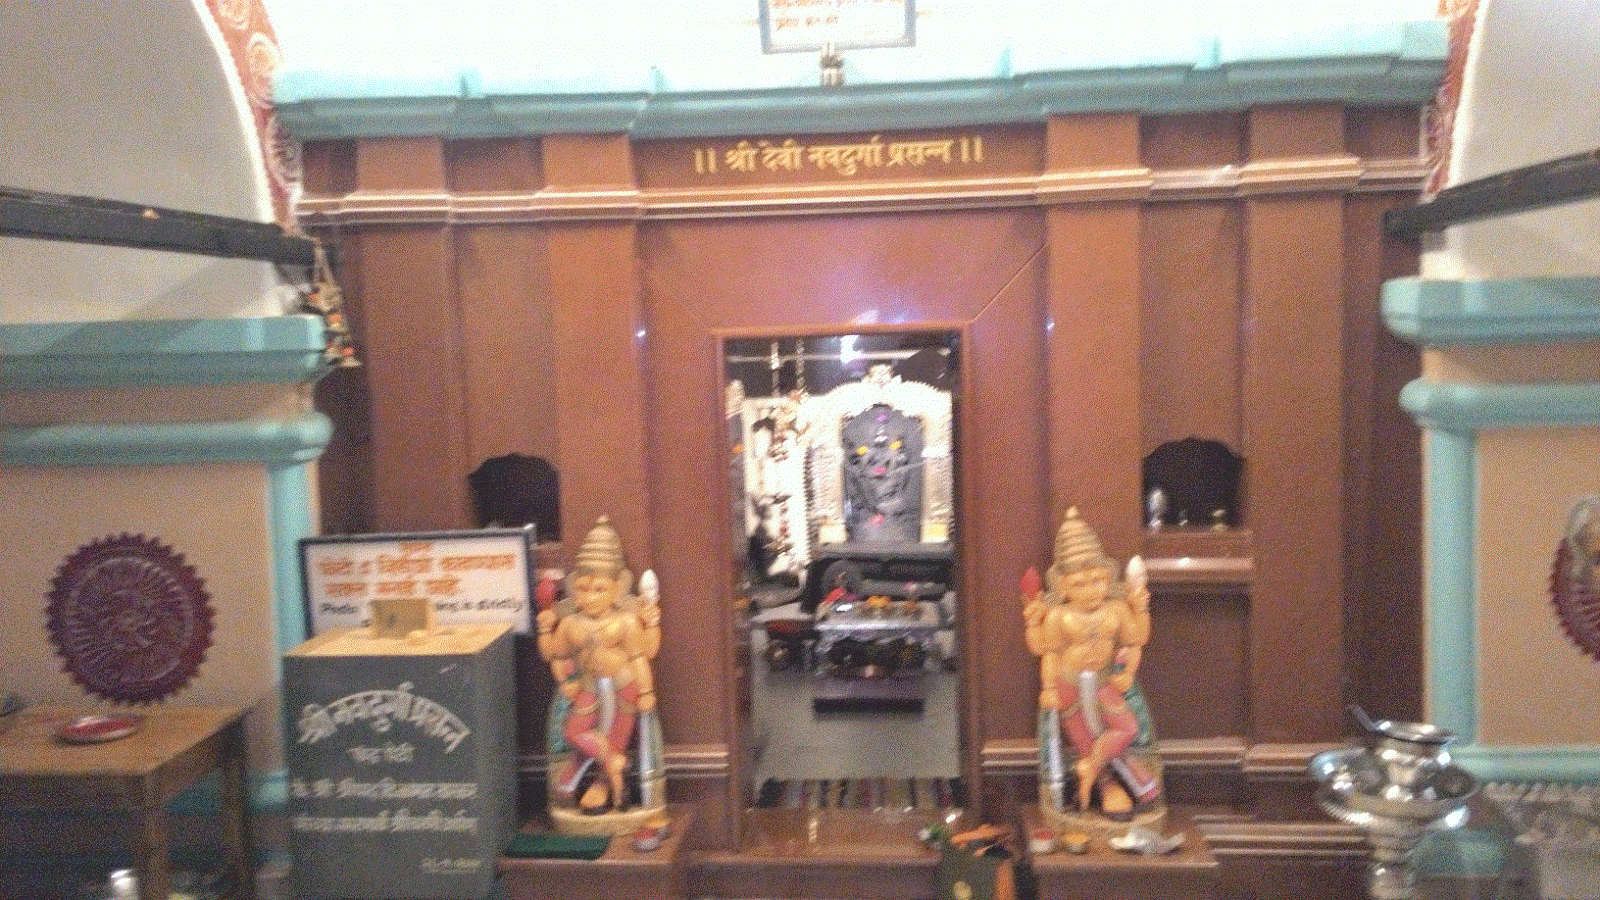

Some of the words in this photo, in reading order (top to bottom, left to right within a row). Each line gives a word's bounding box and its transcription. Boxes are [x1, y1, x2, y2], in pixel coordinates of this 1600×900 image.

[725, 140, 757, 172] श्री
[758, 138, 804, 171] देवी
[807, 134, 886, 176] नवदुर्गा
[886, 139, 955, 168] प्रसन्न
[298, 703, 338, 744] श्री
[329, 681, 415, 733] नवदुर्गा
[409, 695, 472, 755] प्रसन्न
